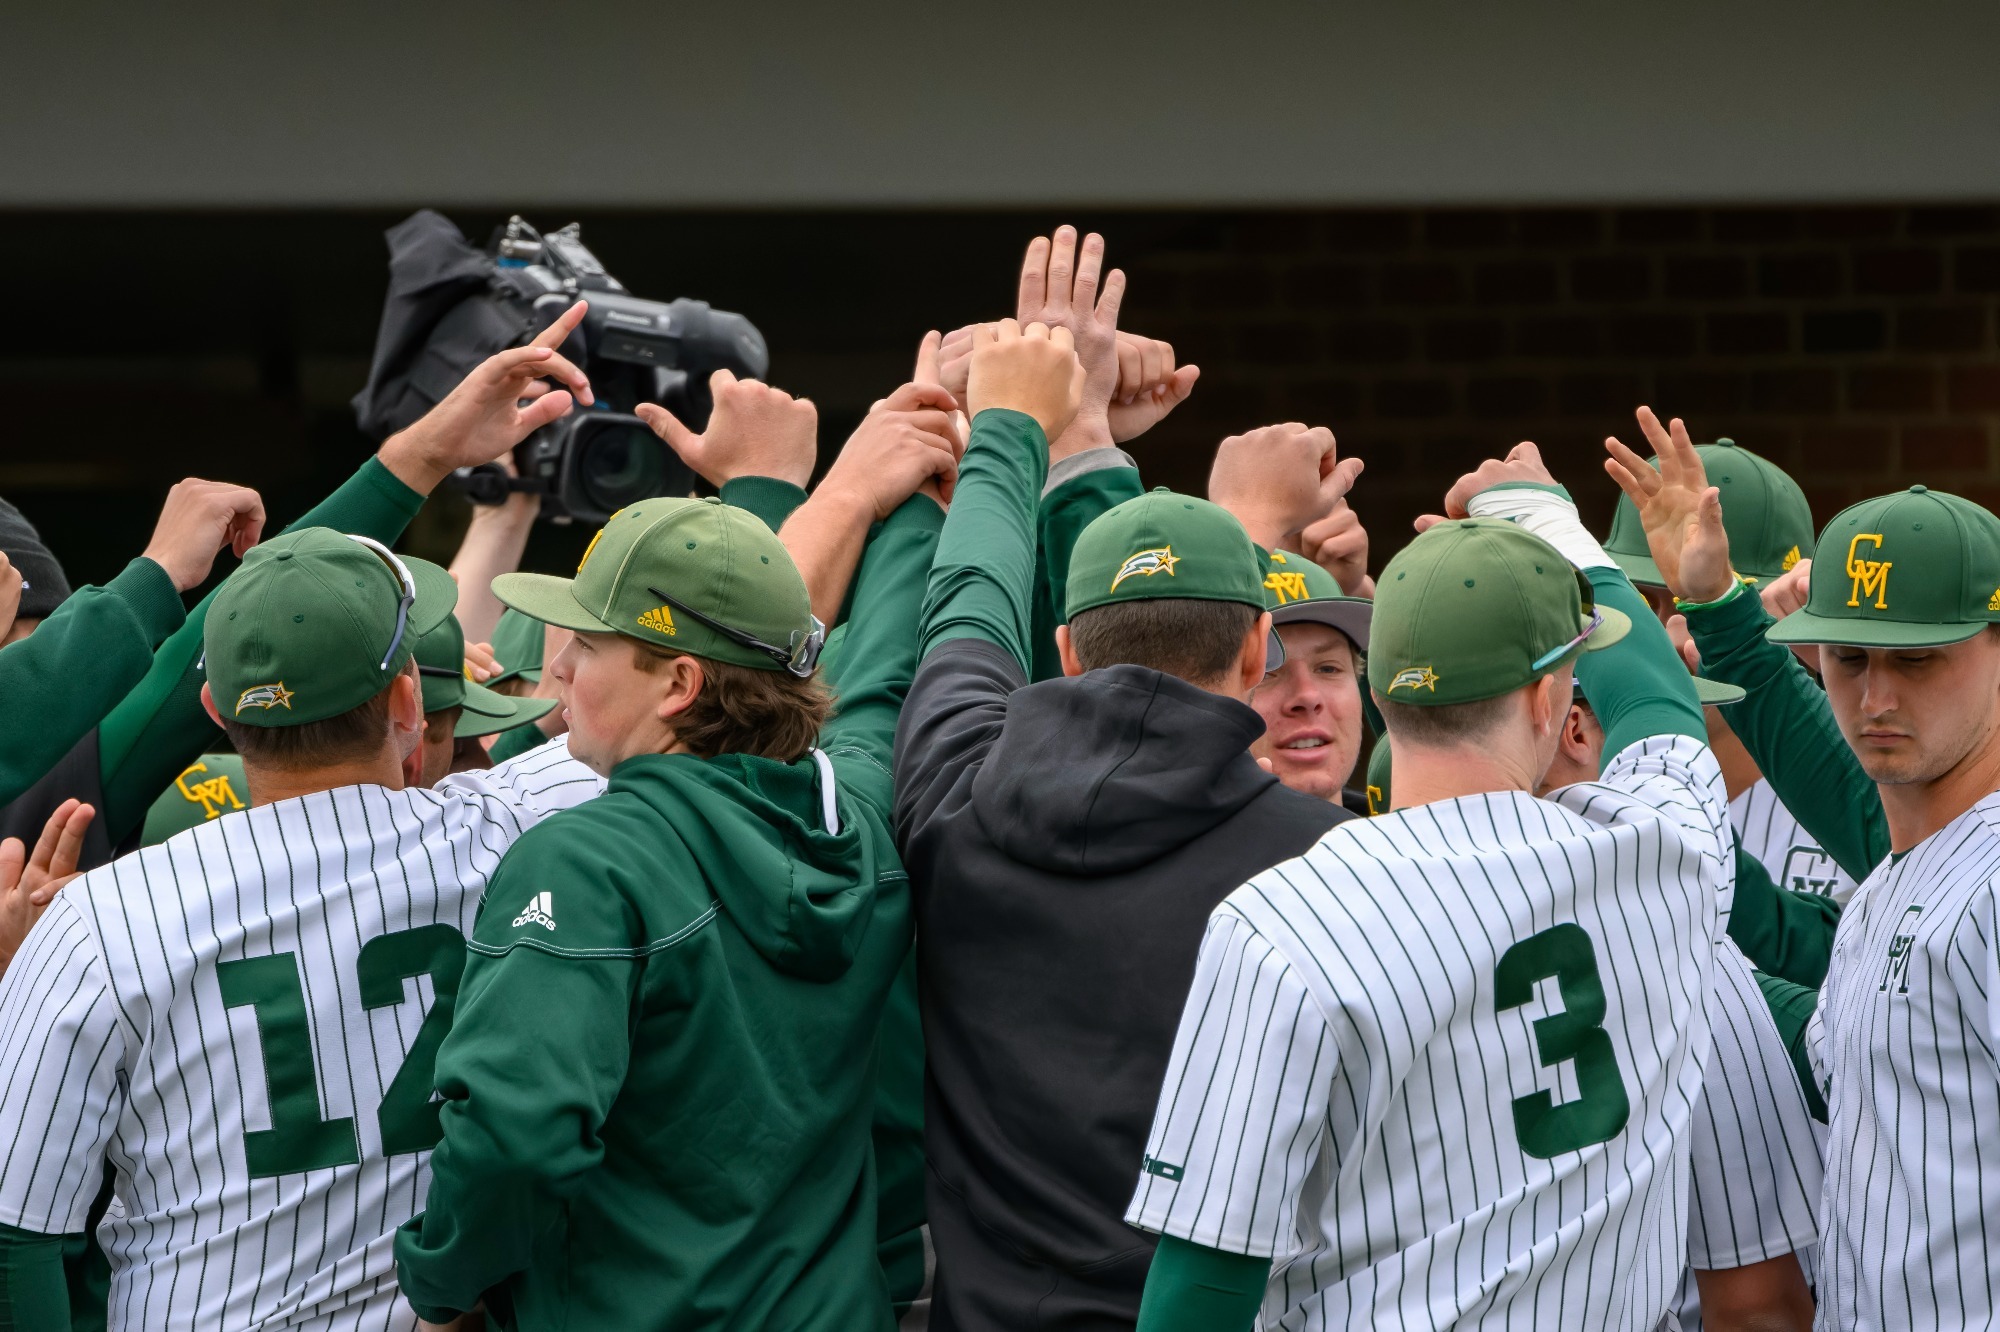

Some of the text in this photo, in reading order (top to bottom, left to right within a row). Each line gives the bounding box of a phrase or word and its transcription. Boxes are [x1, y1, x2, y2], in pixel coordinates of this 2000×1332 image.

[636, 616, 677, 636] adidas
[512, 908, 557, 931] adidas
[215, 922, 468, 1180] 12
[1495, 922, 1630, 1160] 3
